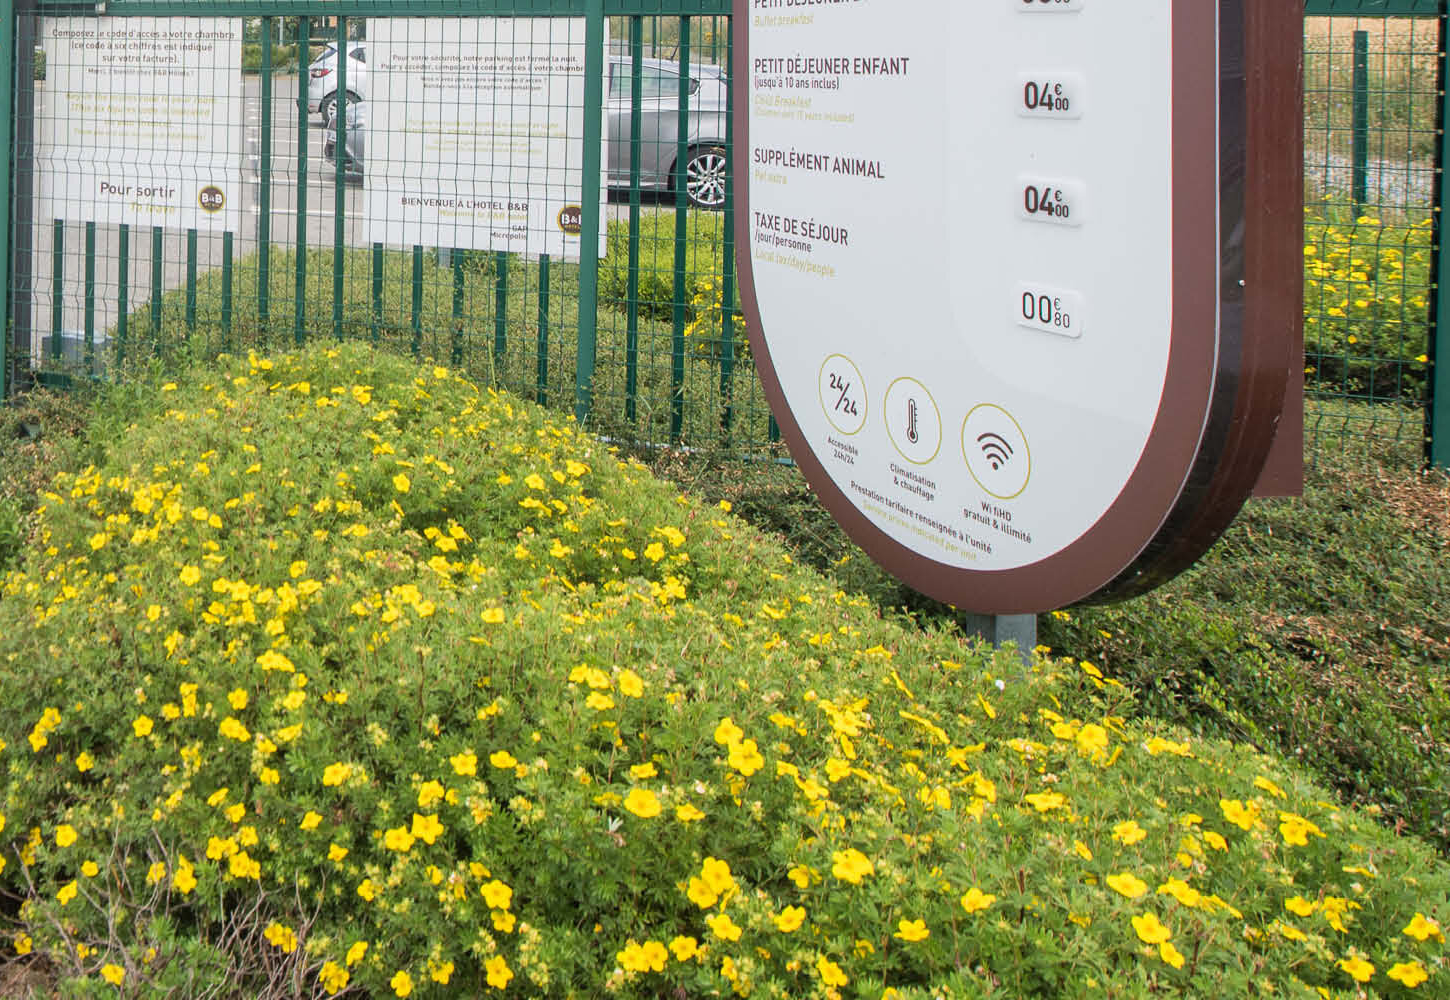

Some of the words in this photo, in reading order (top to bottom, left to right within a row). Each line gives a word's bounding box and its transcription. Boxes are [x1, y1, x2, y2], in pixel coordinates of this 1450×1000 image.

[53, 29, 94, 40] Composez
[107, 29, 127, 38] code
[195, 30, 235, 39] chambre
[86, 41, 105, 49] code
[129, 42, 161, 51] chiffres
[754, 58, 784, 73] PETIT
[787, 53, 850, 74] DÉJEUNER
[853, 57, 910, 75] ENFANT
[754, 77, 783, 90] (jusqu'à
[785, 77, 794, 88] 10
[796, 78, 809, 88] ans
[811, 77, 840, 90] inclus)
[754, 147, 830, 172] SUPPLÉMENT
[833, 157, 885, 178] ANIMAL
[100, 182, 132, 195] Pour
[136, 185, 175, 198] sortir
[201, 193, 223, 204] B&B
[401, 197, 455, 207] BIENVENUE
[508, 202, 529, 212] B&B
[755, 212, 780, 231] TAXE
[784, 218, 798, 235] DE
[801, 218, 848, 246] SÉJOUR
[828, 436, 859, 457] Accessible
[890, 463, 936, 490] Climatisation
[894, 476, 899, 486] &
[900, 480, 935, 501] chauffage
[851, 480, 885, 504] Prestation
[886, 497, 914, 517] tarifaire
[915, 511, 957, 538] renseignée
[958, 531, 964, 542] à
[966, 534, 992, 554] l'unité
[963, 508, 990, 526] gratuit
[992, 519, 999, 529] &
[1000, 521, 1031, 544] illimité
